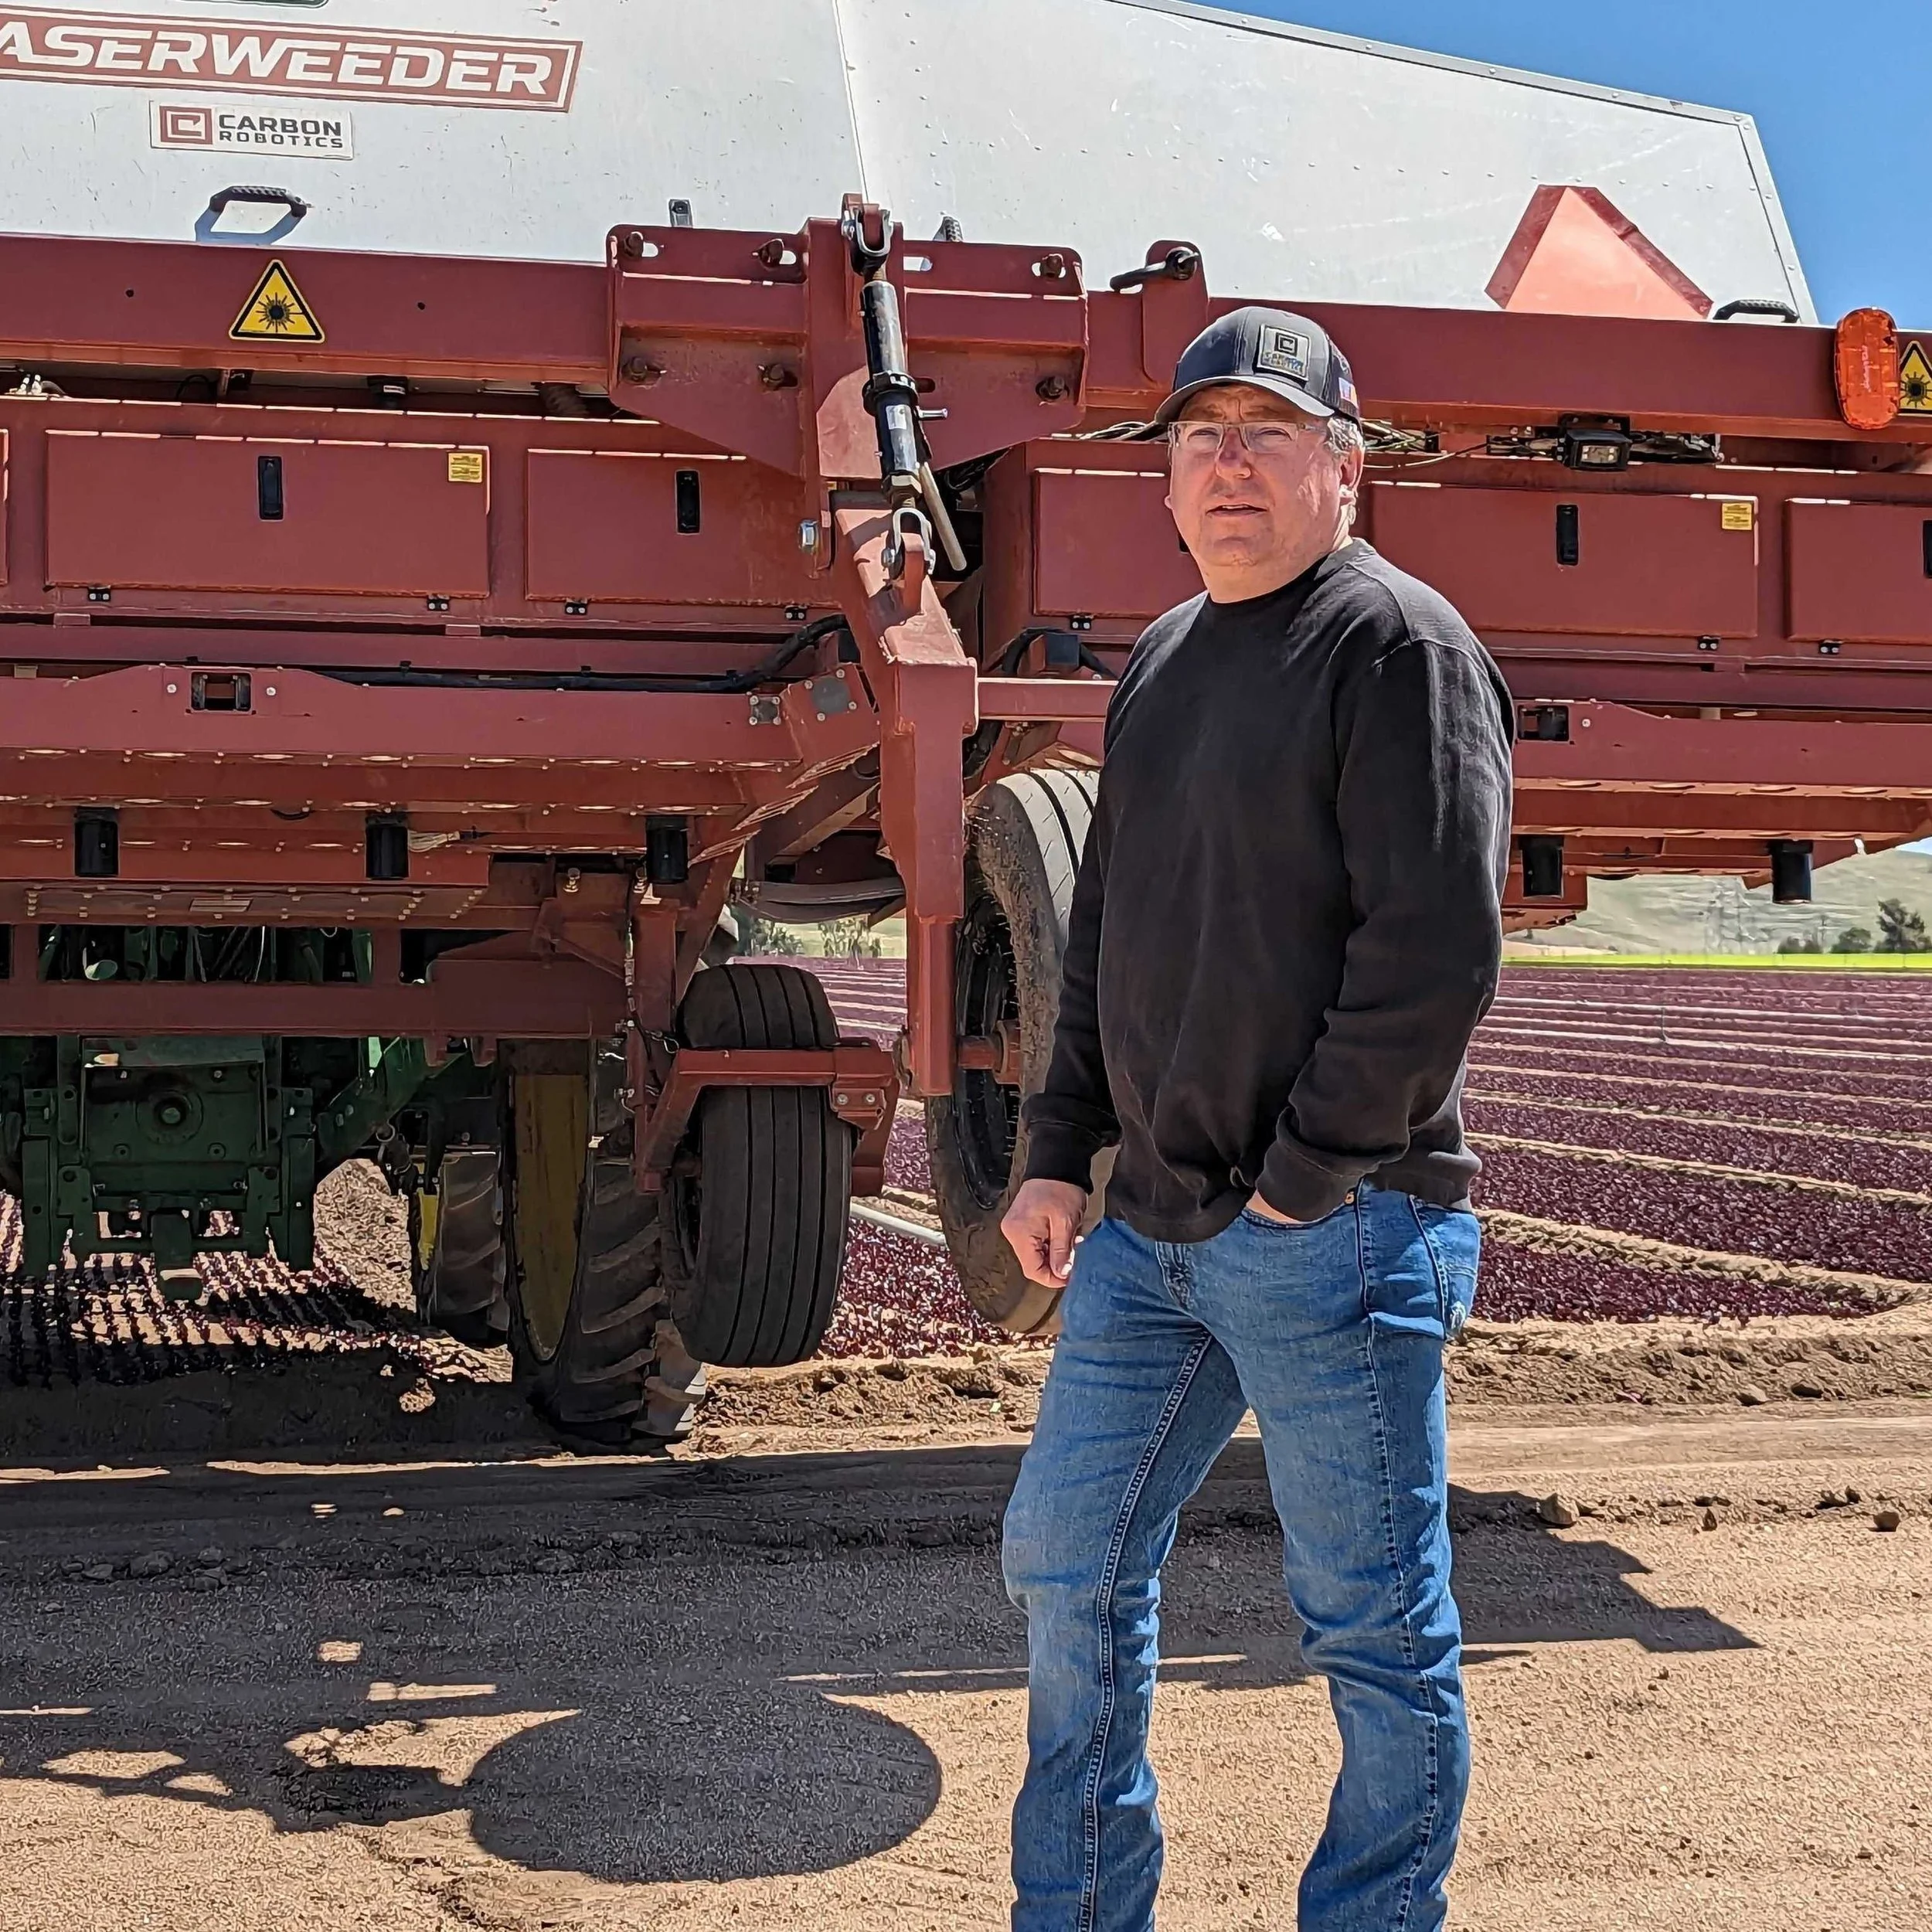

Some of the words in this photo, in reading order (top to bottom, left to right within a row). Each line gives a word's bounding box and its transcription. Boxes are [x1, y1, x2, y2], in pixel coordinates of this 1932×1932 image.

[0, 21, 552, 94] ASERWEEDER
[219, 114, 342, 137] CARBON
[219, 131, 344, 148] ROBOTICS
